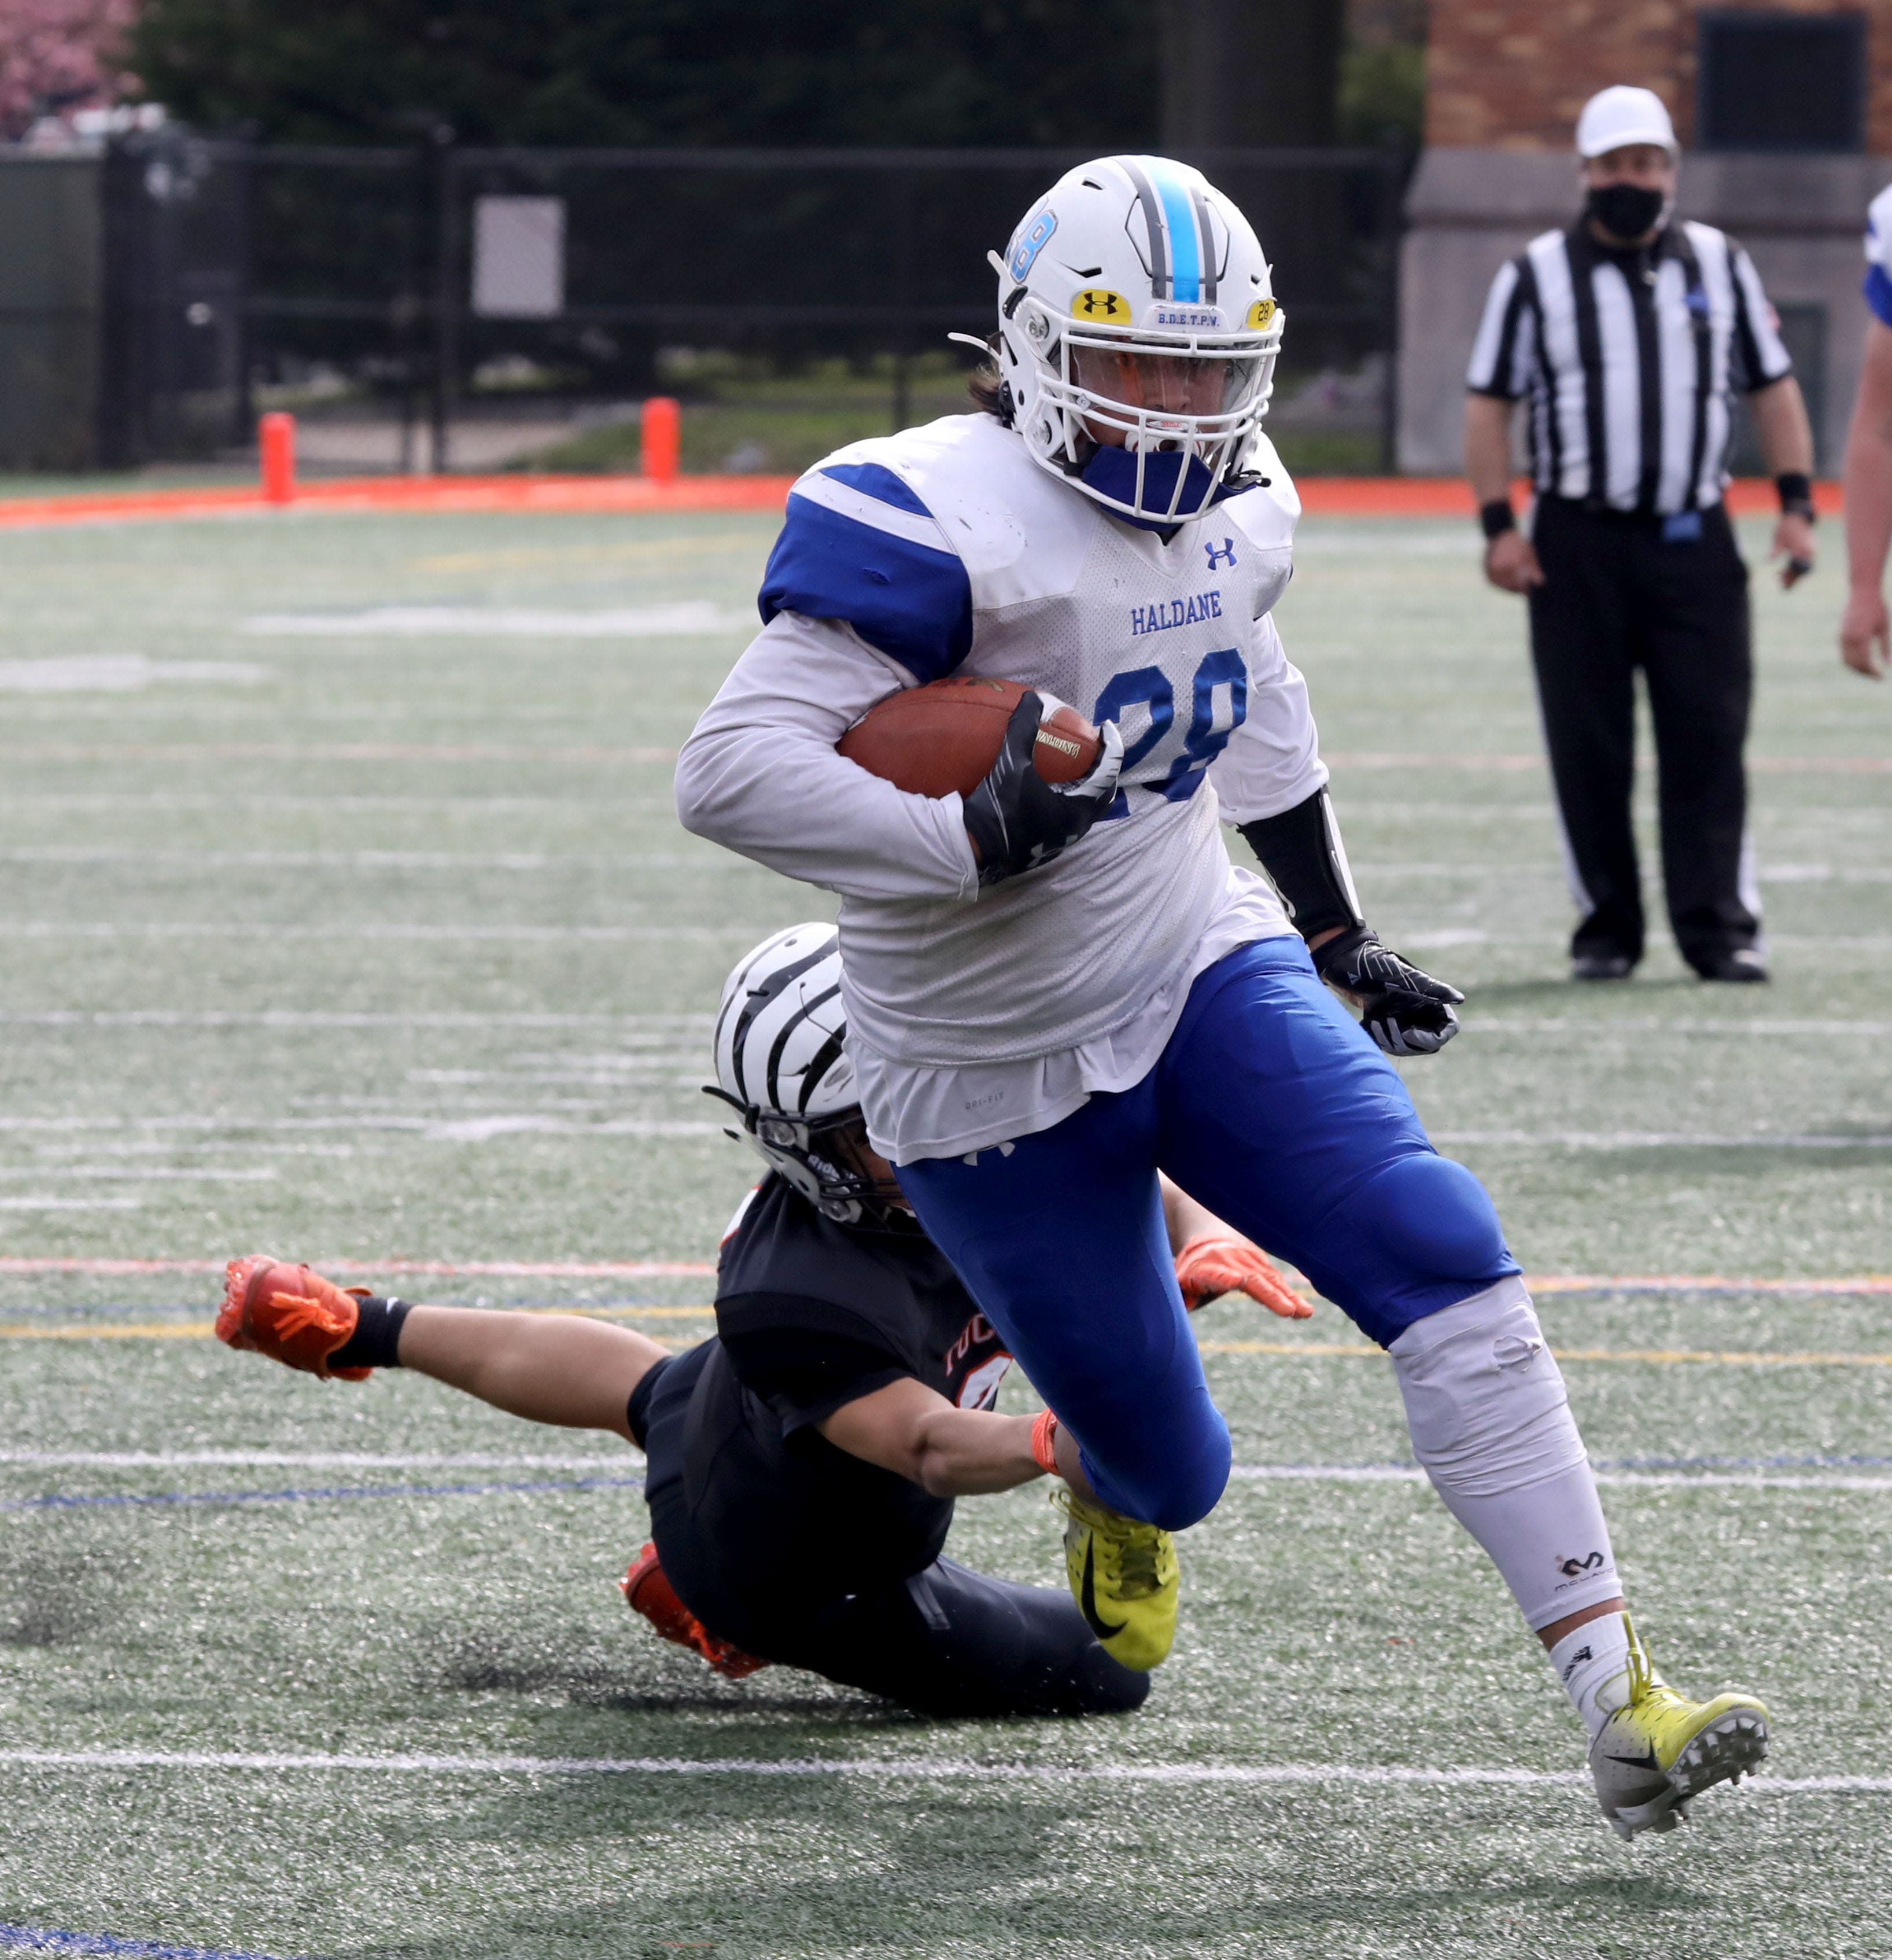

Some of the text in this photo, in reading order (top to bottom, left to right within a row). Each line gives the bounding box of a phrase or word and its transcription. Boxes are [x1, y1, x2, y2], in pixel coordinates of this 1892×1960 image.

[1257, 302, 1270, 322] 28
[1131, 590, 1222, 635] HALDANE
[1035, 728, 1080, 758] PALDING
[1093, 647, 1248, 820] 28
[965, 1092, 1004, 1110] DRI-FIT
